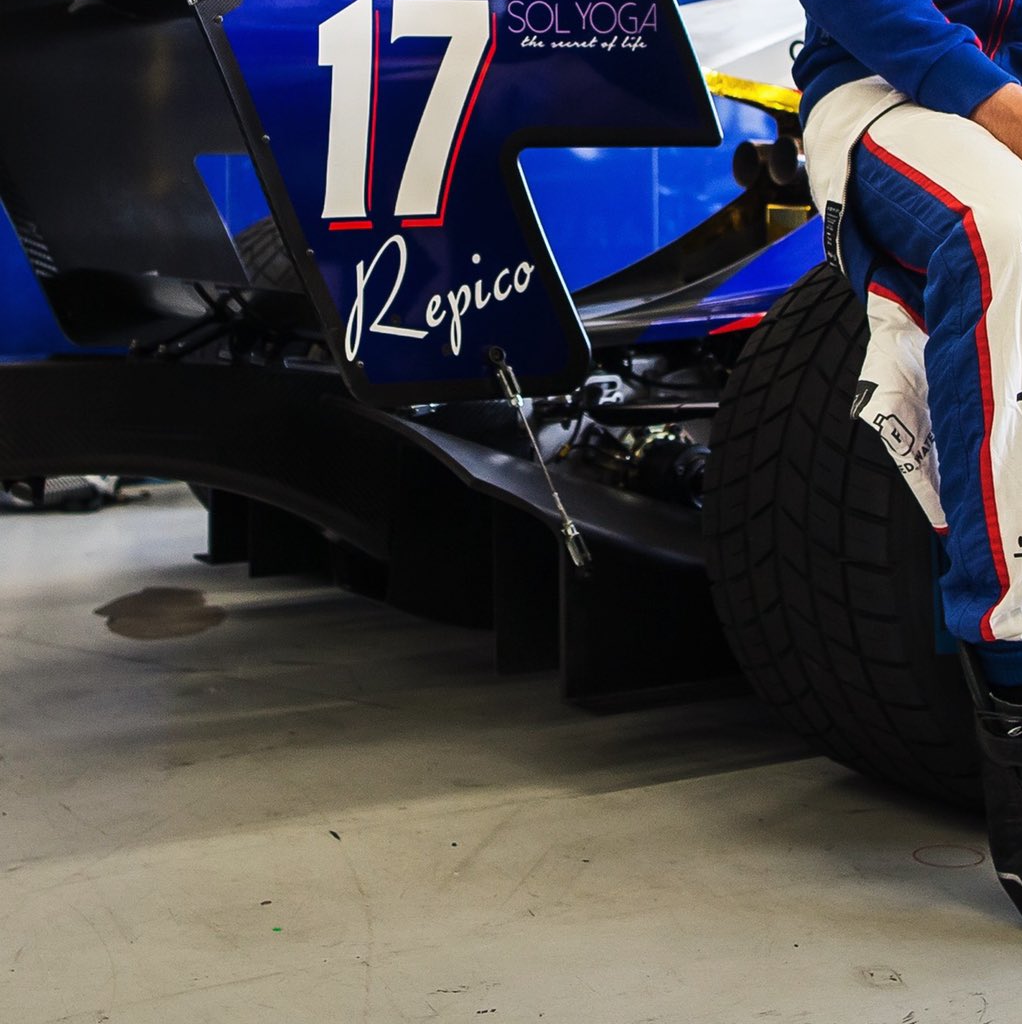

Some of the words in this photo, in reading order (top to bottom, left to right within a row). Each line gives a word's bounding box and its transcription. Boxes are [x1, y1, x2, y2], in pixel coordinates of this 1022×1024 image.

[507, 0, 570, 34] SOL
[575, 0, 657, 35] YOGA
[520, 35, 545, 48] the
[550, 36, 598, 49] secret
[601, 36, 618, 51] of
[621, 36, 647, 52] life
[345, 234, 534, 362] Repico
